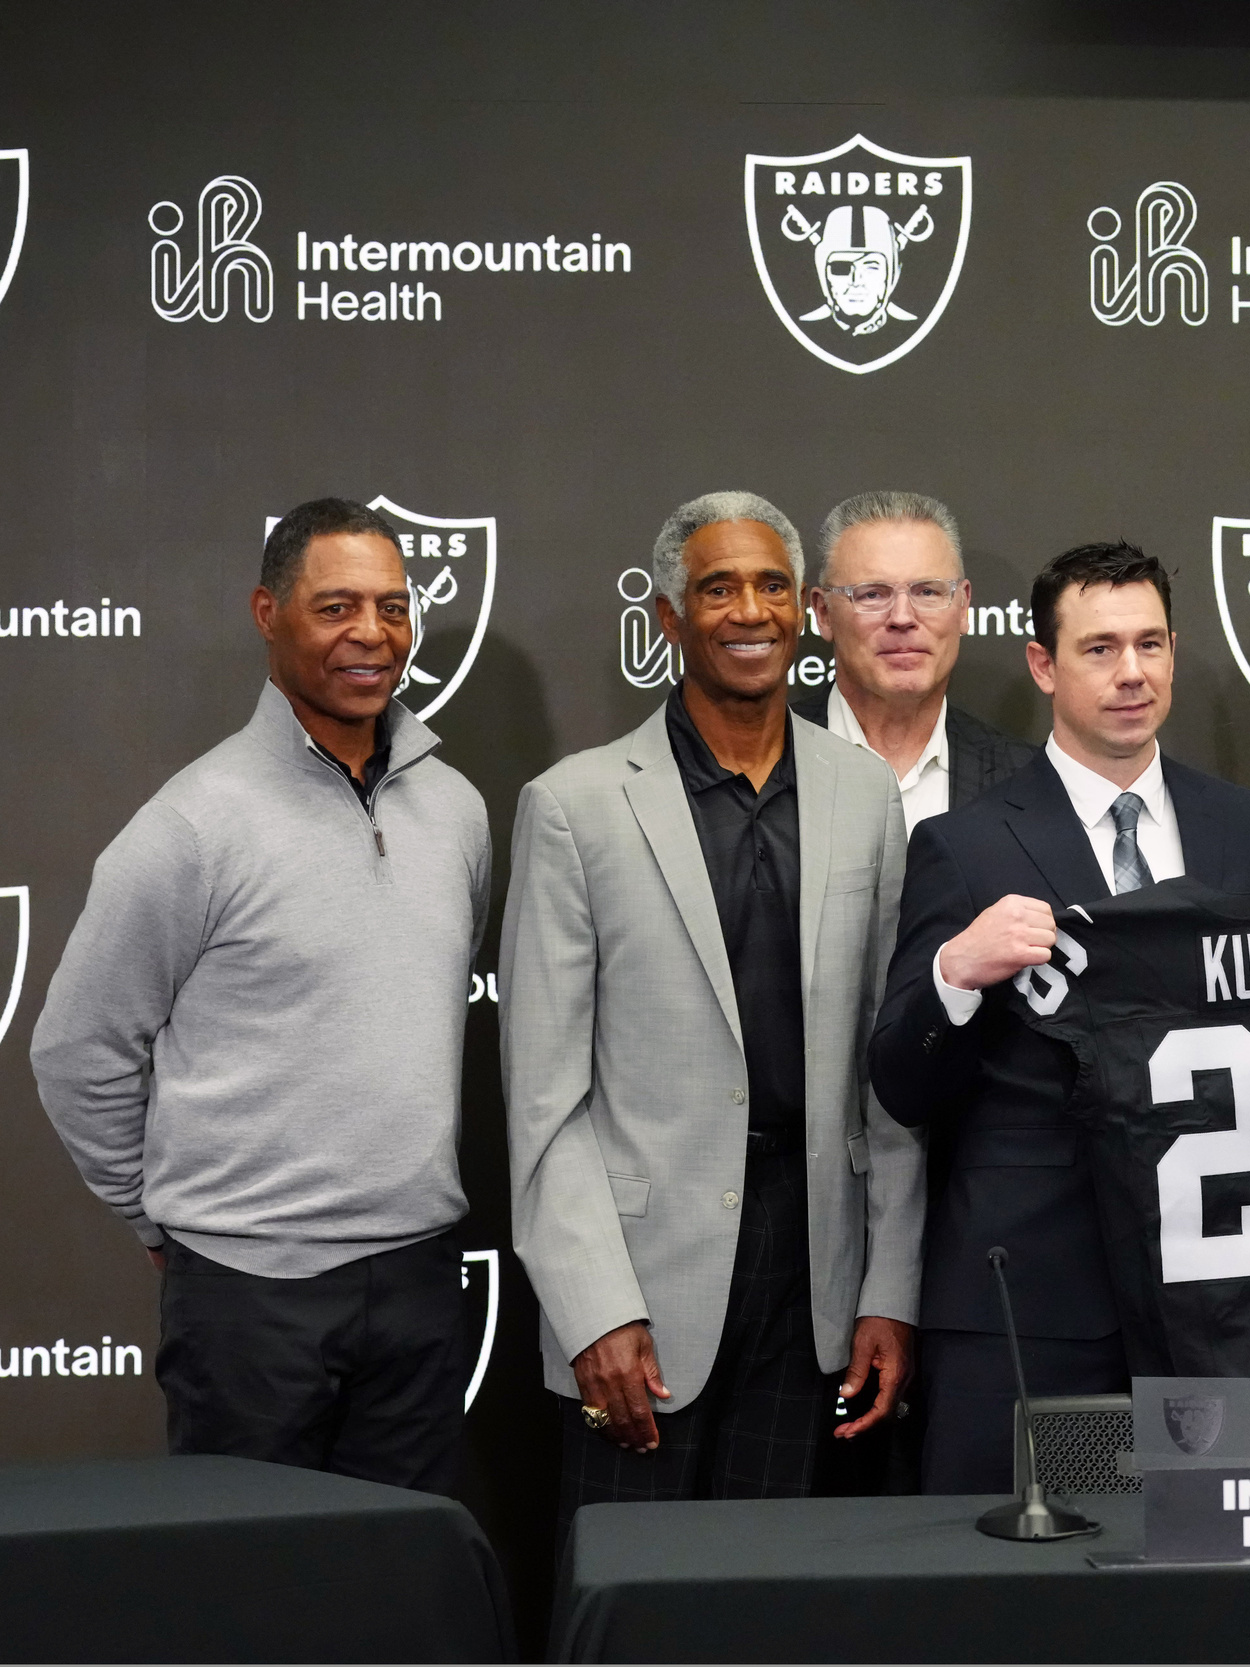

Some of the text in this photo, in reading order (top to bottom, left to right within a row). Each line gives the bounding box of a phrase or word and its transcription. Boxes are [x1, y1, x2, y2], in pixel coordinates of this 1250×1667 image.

[776, 172, 943, 197] RAIDERS
[297, 231, 632, 273] Intermountain
[297, 281, 442, 322] Health
